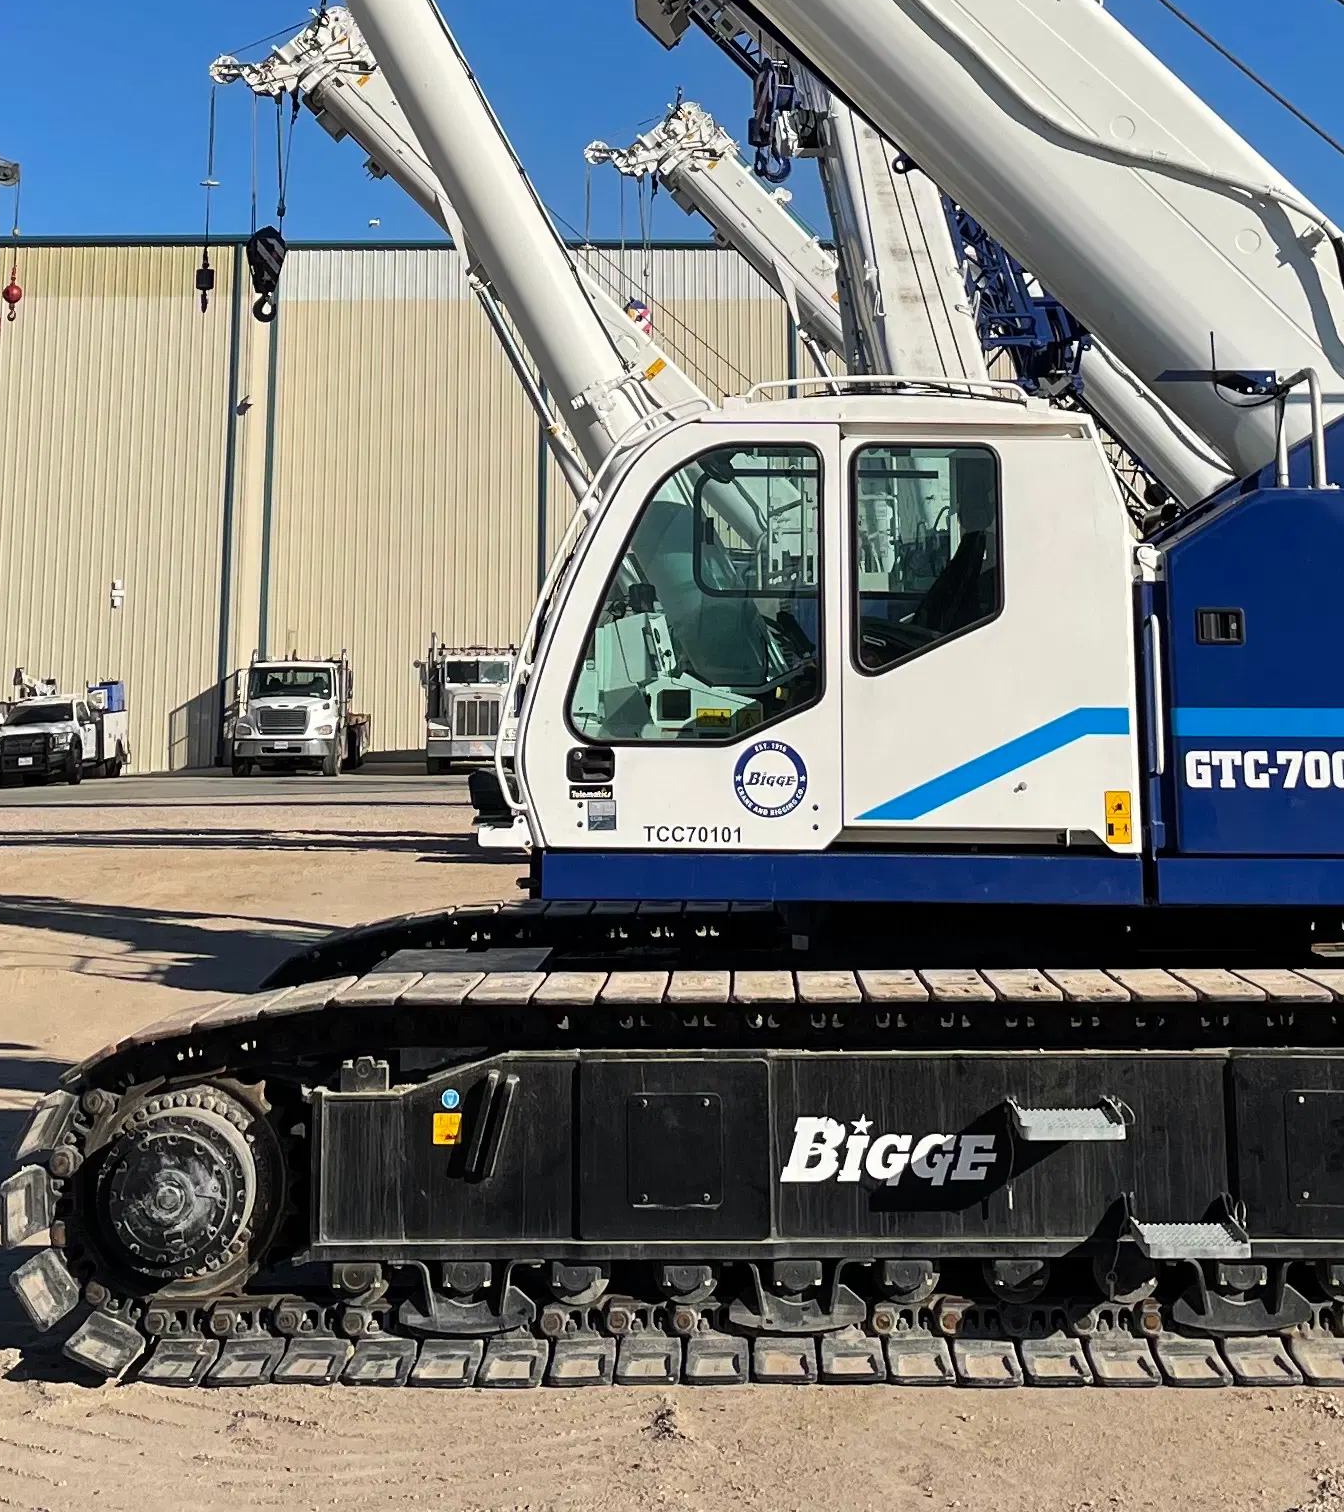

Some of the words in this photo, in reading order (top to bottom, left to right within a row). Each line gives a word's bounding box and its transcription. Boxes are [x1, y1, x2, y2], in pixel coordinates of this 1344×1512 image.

[737, 786, 754, 809] CRANE
[753, 805, 769, 816] AND
[769, 799, 798, 816] RIGGING
[642, 825, 742, 844] TCC70101
